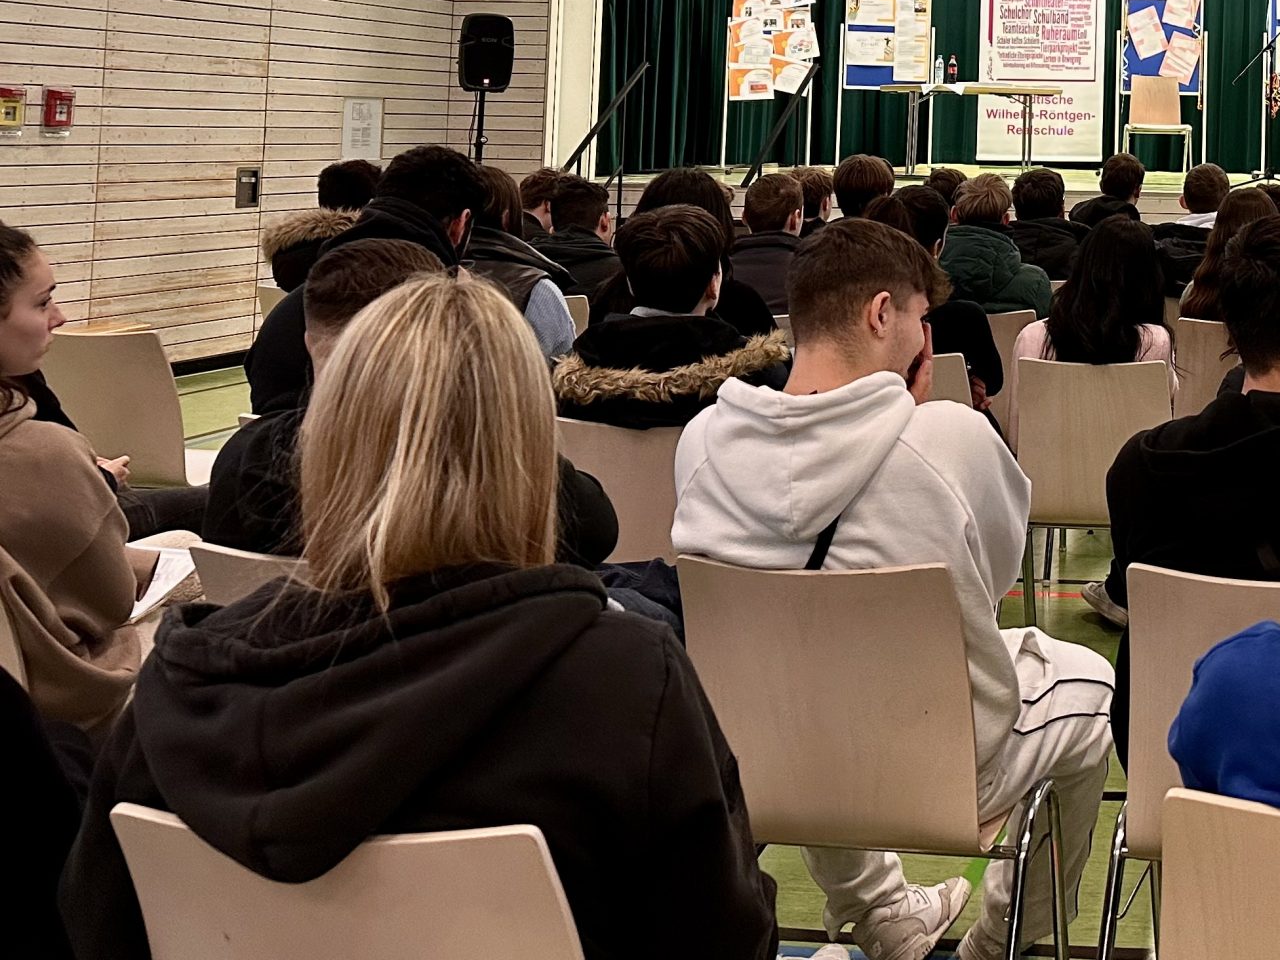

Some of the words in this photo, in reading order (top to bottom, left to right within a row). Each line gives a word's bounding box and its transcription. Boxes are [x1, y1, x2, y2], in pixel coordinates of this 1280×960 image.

[1000, 5, 1031, 19] Schulchor
[1034, 9, 1068, 24] Schulband
[1003, 22, 1039, 37] Teamteaching
[1042, 26, 1077, 40] Ruheraum
